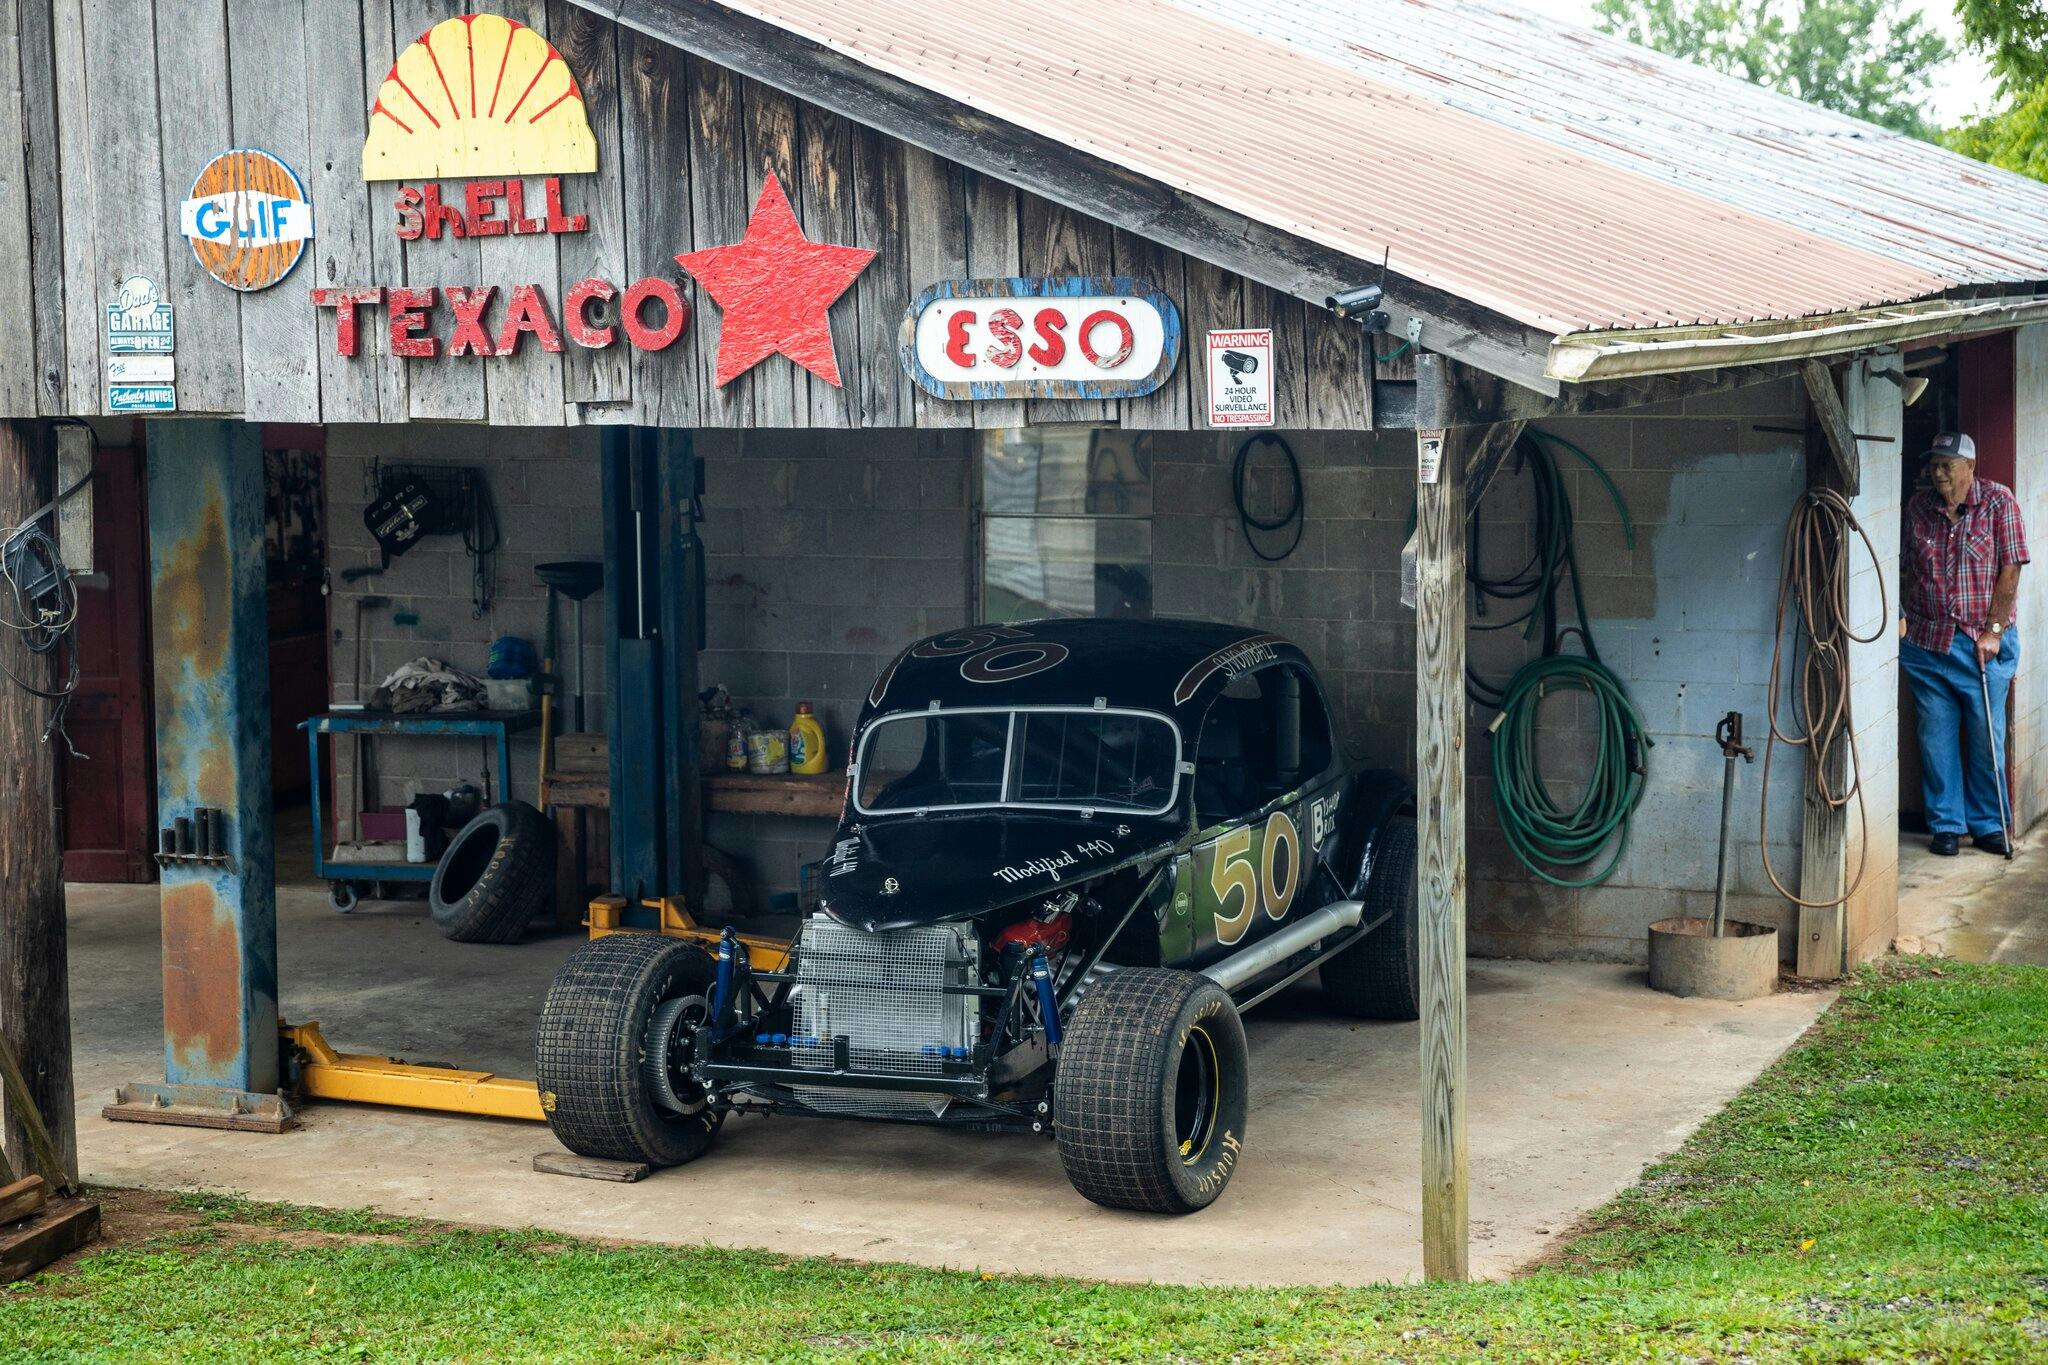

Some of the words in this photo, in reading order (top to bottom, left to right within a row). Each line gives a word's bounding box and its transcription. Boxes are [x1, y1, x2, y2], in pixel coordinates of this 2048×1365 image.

[110, 312, 171, 332] GARAGE
[310, 277, 691, 357] TEXACO
[110, 336, 135, 346] ALWAYS
[134, 336, 160, 350] OPEN
[945, 307, 1134, 369] ESSO
[1210, 334, 1269, 347] WARNING
[144, 389, 172, 403] ADVICE
[1224, 387, 1233, 395] 24
[1235, 387, 1257, 395] HOUR
[1229, 395, 1253, 403] VIDEO
[1215, 403, 1268, 412] SURVEILLANCE
[1214, 414, 1225, 423] NO
[1226, 414, 1270, 423] TRESPASSING
[1212, 640, 1278, 680] SNOWBALL
[992, 850, 1079, 883] Modified
[1076, 839, 1115, 859] 440
[1211, 811, 1300, 946] 50
